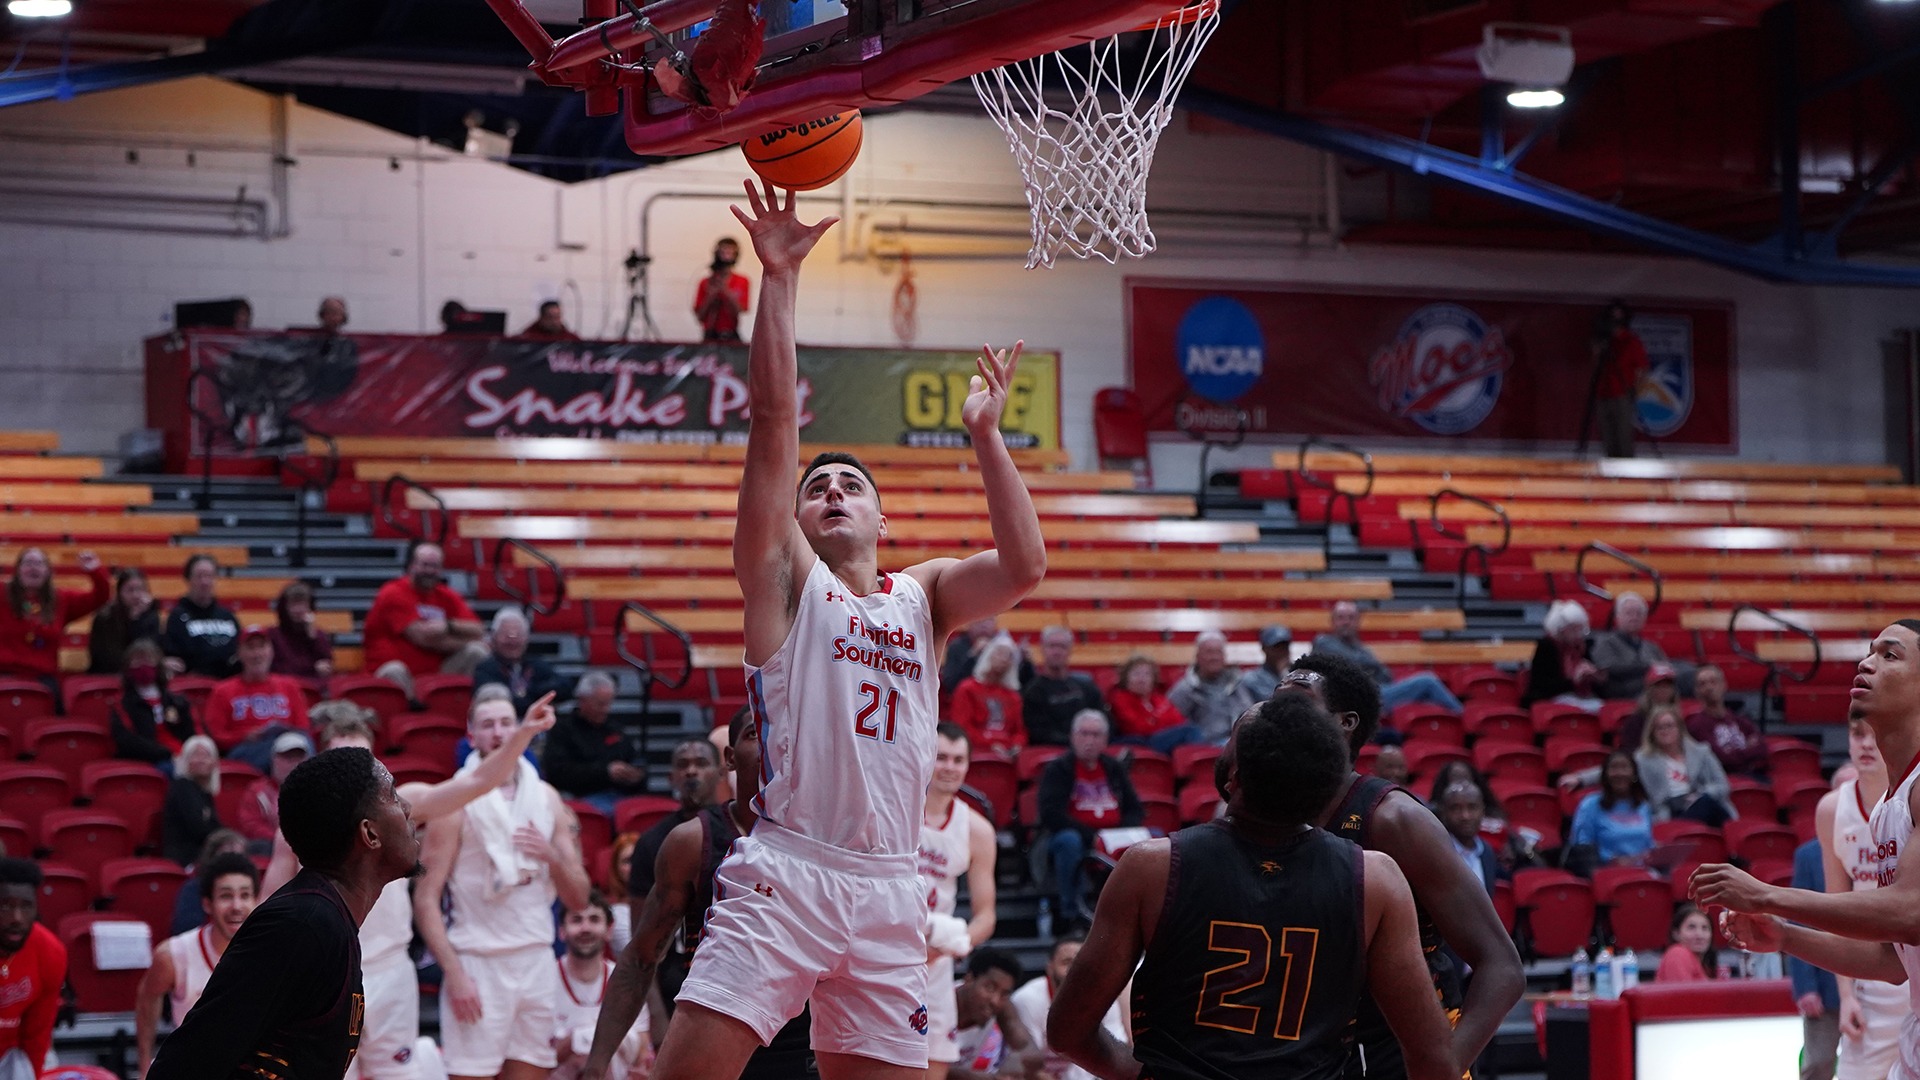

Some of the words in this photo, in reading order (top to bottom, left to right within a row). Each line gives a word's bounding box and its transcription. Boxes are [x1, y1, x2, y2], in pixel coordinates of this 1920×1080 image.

[1186, 344, 1263, 376] NCAA
[465, 365, 688, 428] Snake
[709, 371, 814, 428] Pt
[1178, 402, 1251, 430] Division
[847, 613, 916, 652] Florida
[831, 634, 924, 683] Southern
[854, 680, 901, 744] 21
[1194, 920, 1319, 1041] 21
